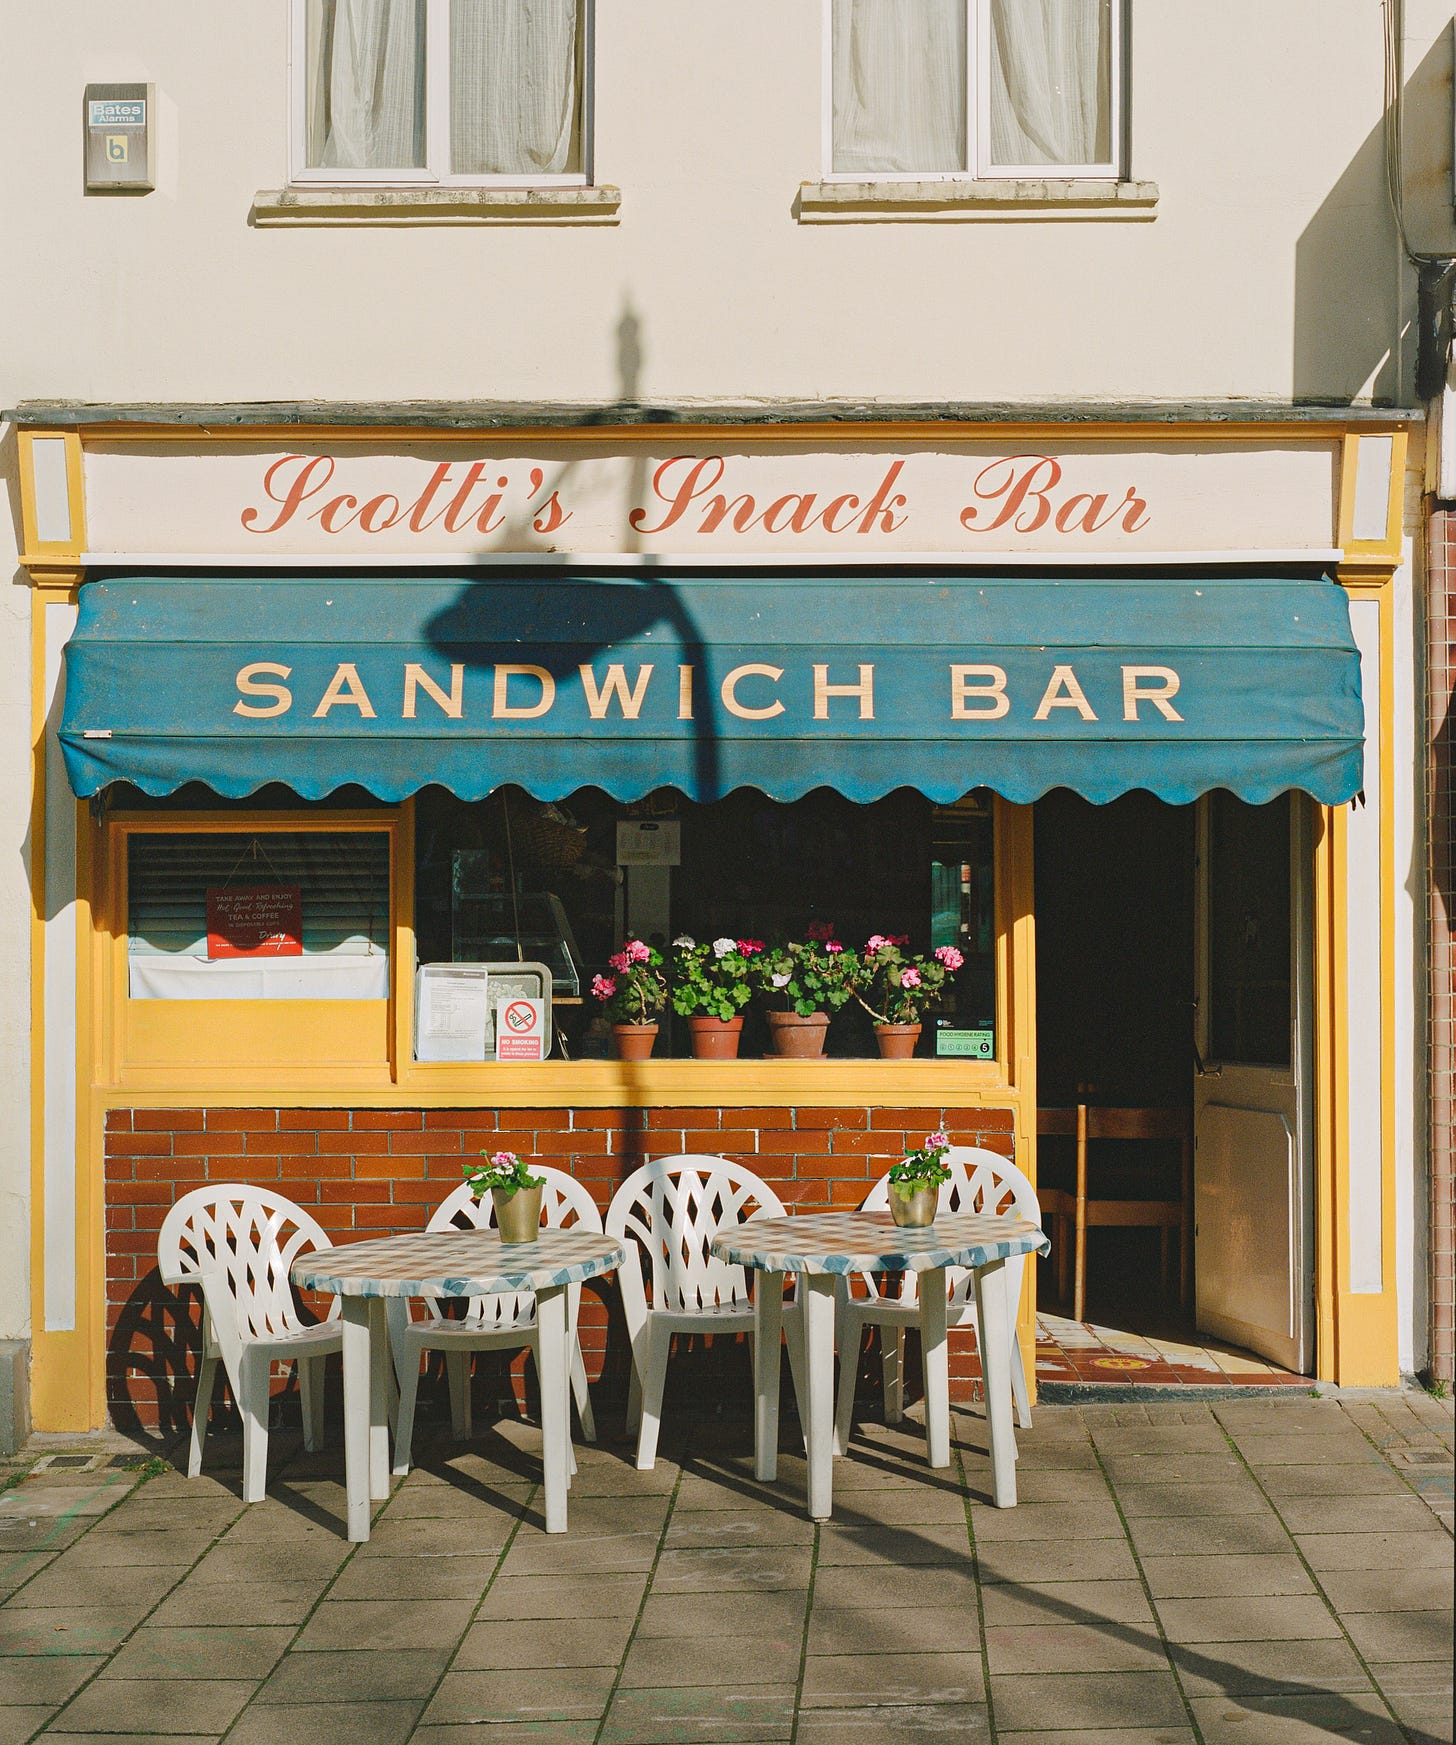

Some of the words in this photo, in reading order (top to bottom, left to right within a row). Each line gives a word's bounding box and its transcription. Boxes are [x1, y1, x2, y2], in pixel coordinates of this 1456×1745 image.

[93, 104, 141, 115] Bates
[241, 455, 574, 534] Scotti's
[629, 455, 908, 534] Snack
[960, 454, 1151, 534] Bar
[232, 662, 875, 720] SANDWICH
[949, 664, 1185, 722] BAR
[272, 893, 292, 901] ENJOY
[252, 912, 279, 920] COFFEE
